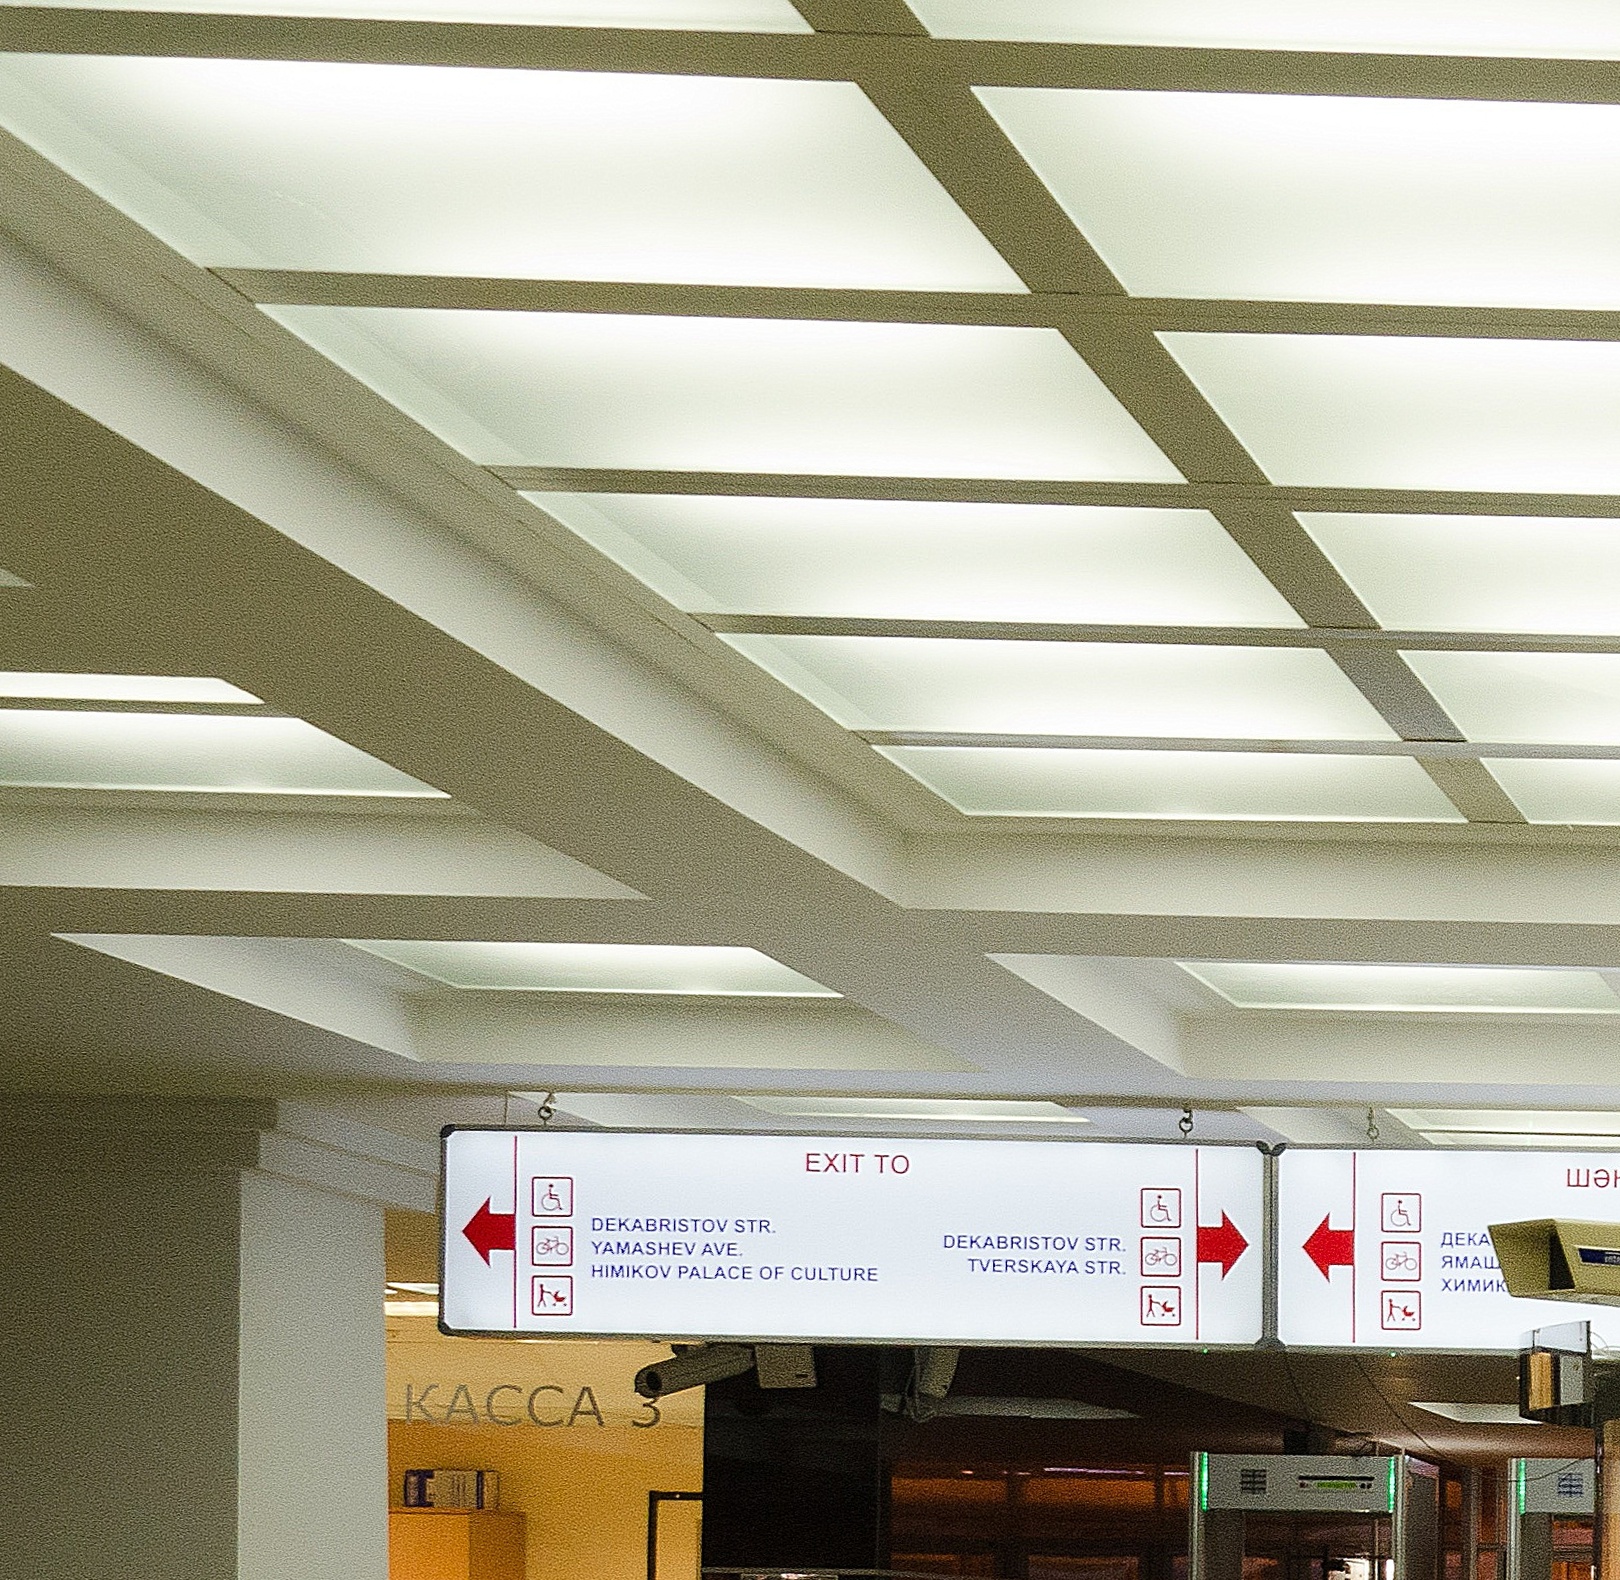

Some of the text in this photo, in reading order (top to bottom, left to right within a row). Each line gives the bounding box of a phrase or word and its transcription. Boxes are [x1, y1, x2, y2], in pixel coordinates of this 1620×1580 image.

[805, 1152, 910, 1175] EXIT TO
[591, 1217, 776, 1234] DEKABRISTOV STR.
[590, 1240, 743, 1257] YAMASHEV AVE.
[943, 1234, 1126, 1252] DEKABRISTOV STR.
[1440, 1232, 1490, 1249] ДЕКА
[967, 1258, 1126, 1275] TVERSKAYA STR.
[1441, 1255, 1501, 1270] ЯМАШ
[591, 1264, 878, 1282] HIMIKOV PALACE OF CULTURE
[1441, 1278, 1507, 1293] ХИМИК
[404, 1384, 662, 1429] КАССА 3
